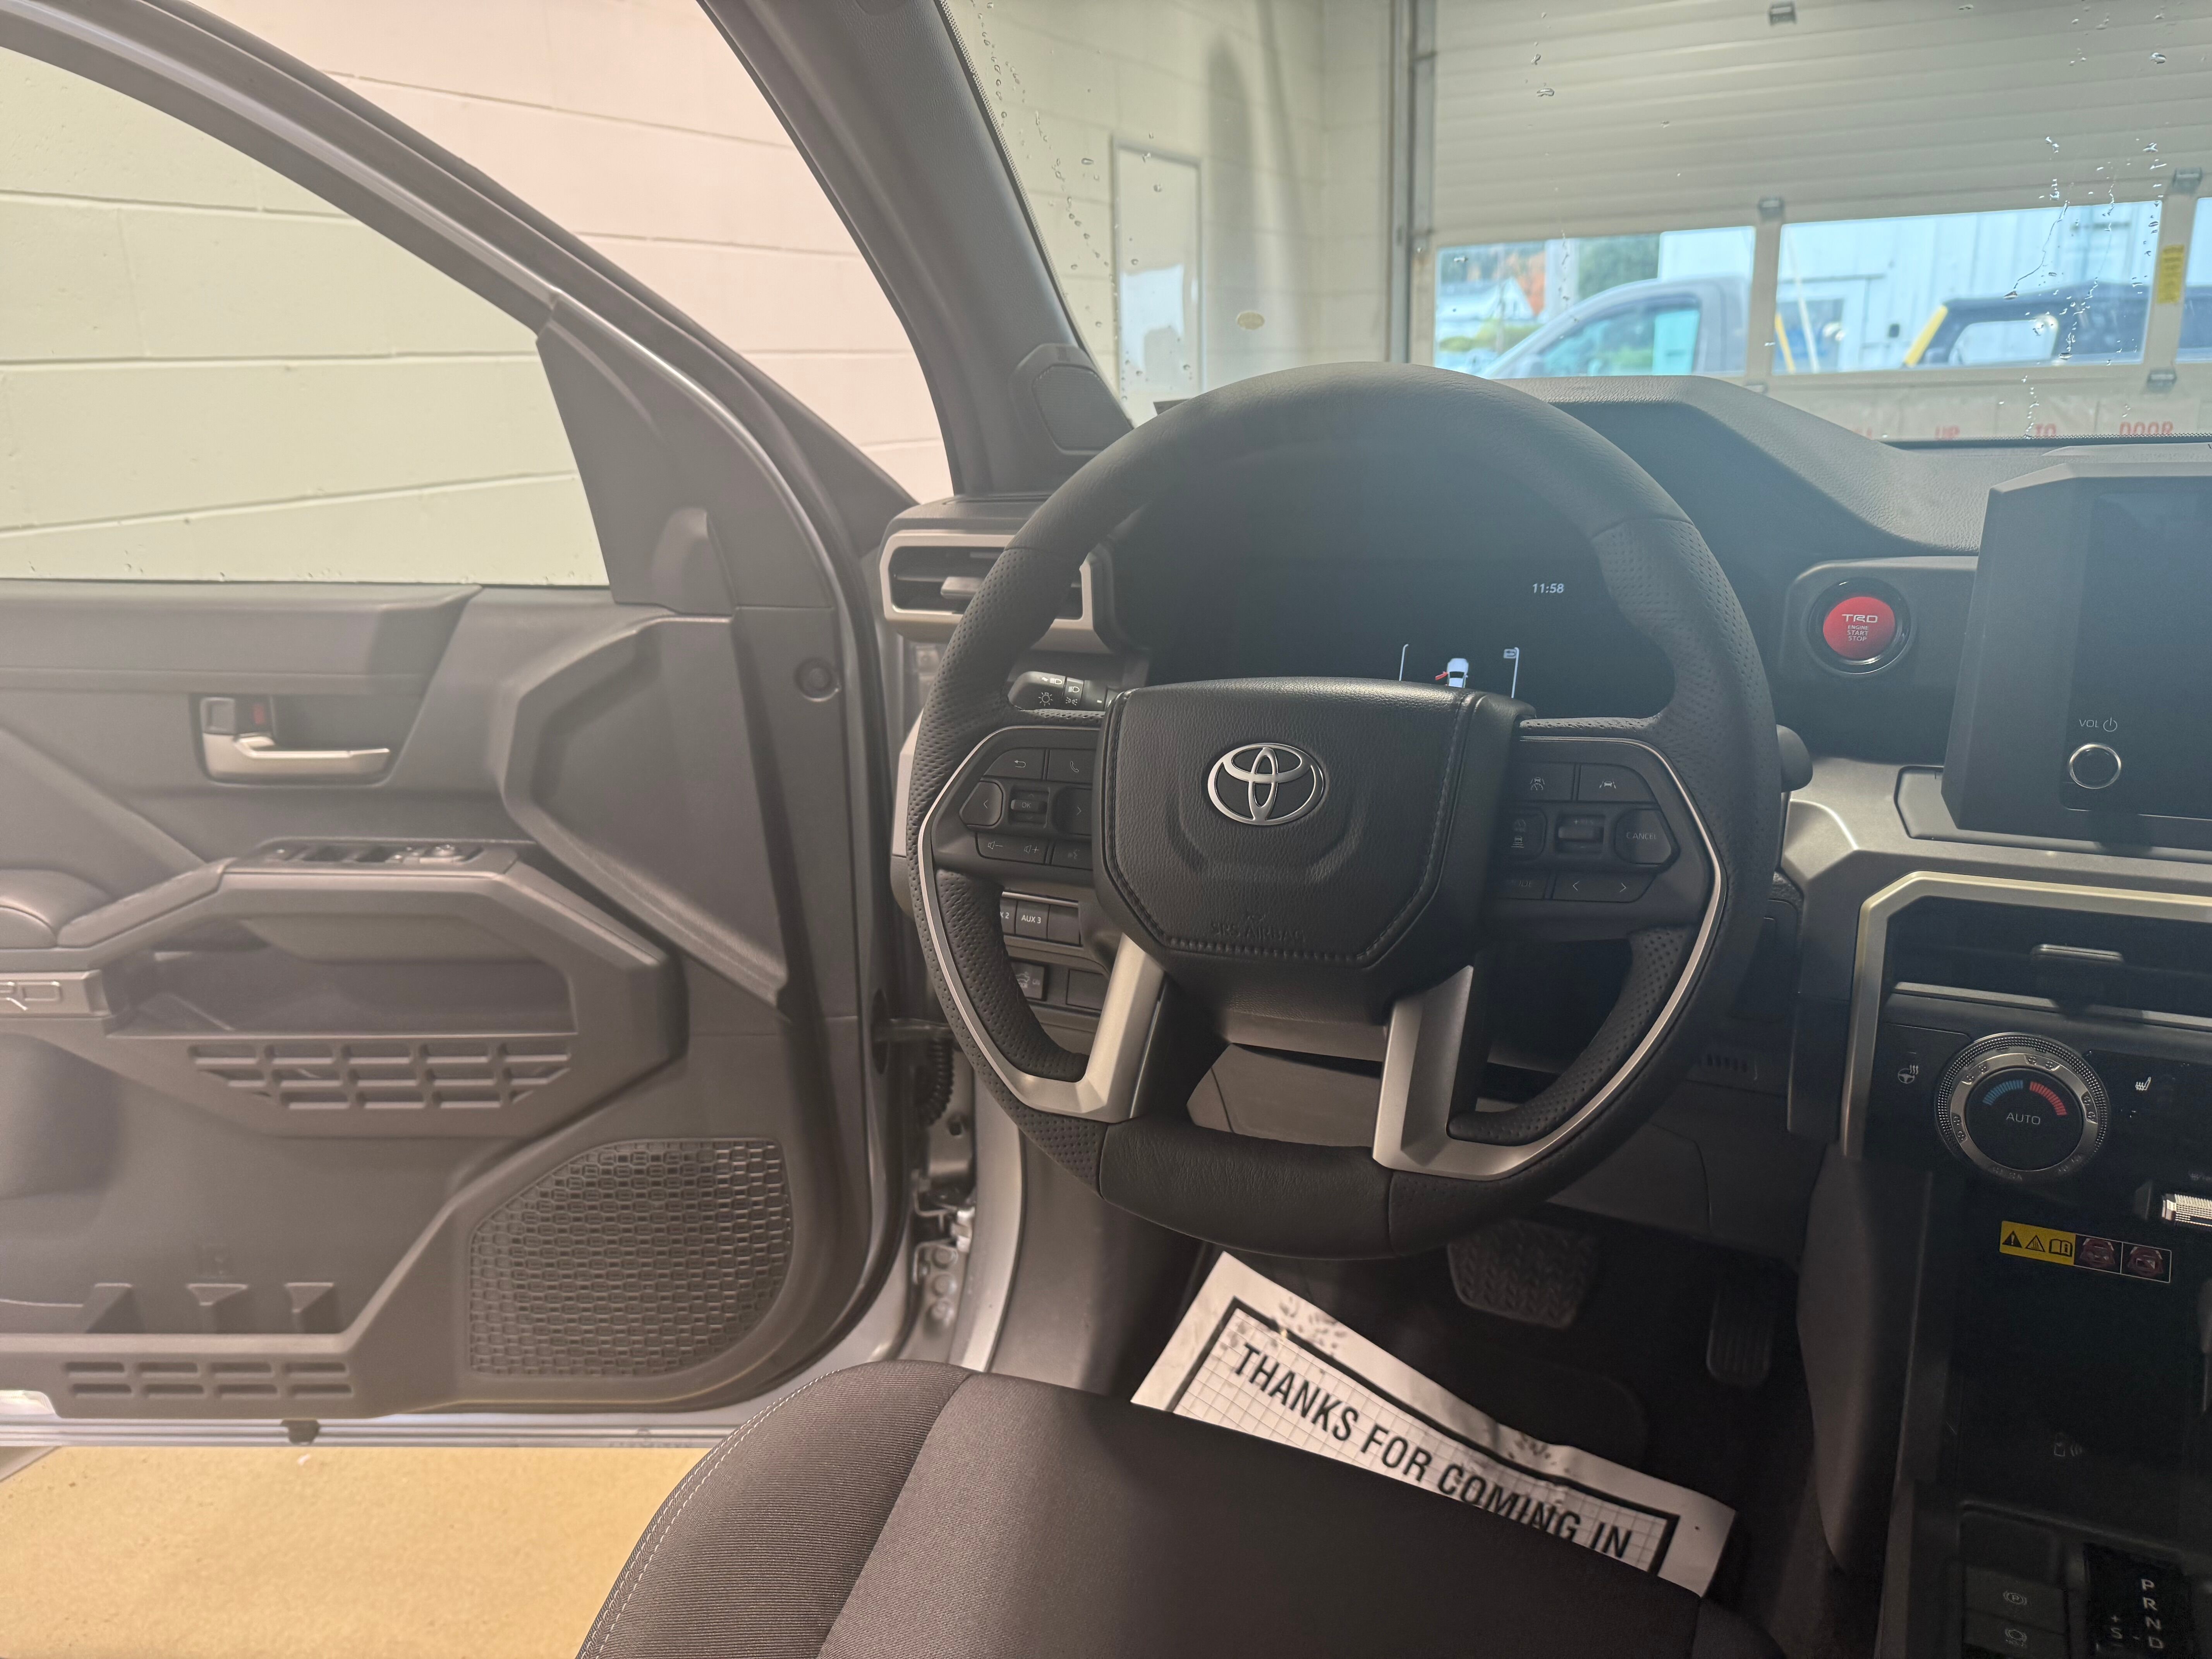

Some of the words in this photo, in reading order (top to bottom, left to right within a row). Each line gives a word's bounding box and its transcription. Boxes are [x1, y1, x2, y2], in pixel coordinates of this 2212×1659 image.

[1532, 583, 1564, 594] 11:58
[1842, 614, 1878, 623] TRD
[2079, 719, 2099, 728] VOL
[1626, 831, 1656, 840] CANCEL
[2006, 1112, 2040, 1125] AUTO
[1231, 1343, 1359, 1441] THANKS
[1360, 1424, 1433, 1482] FOR
[1437, 1463, 1581, 1541] COMING
[1589, 1521, 1633, 1559] IN
[2141, 1578, 2155, 1591] P
[2143, 1597, 2159, 1612] R
[2145, 1615, 2162, 1631] N
[2110, 1626, 2123, 1639] S
[2148, 1636, 2165, 1649] D
